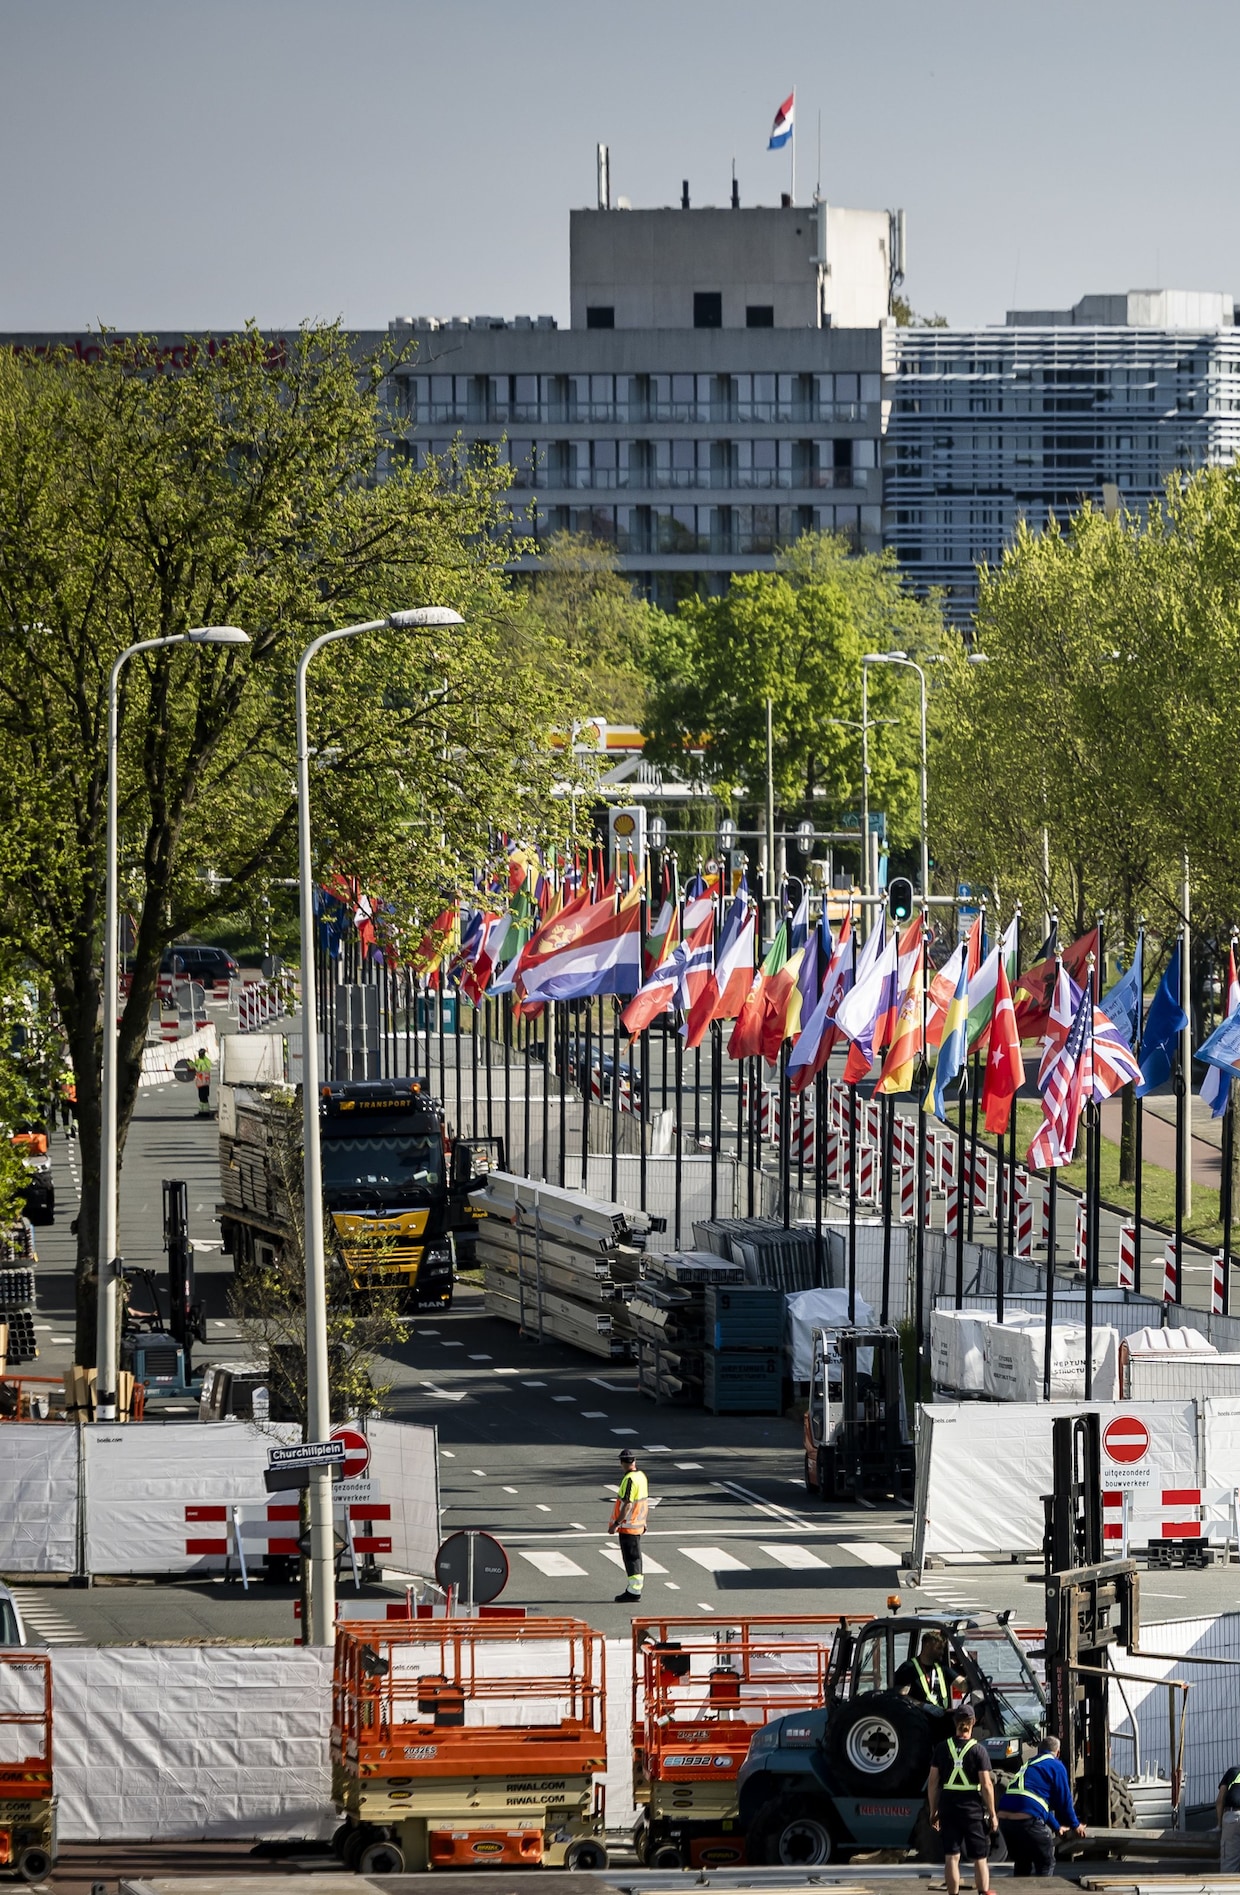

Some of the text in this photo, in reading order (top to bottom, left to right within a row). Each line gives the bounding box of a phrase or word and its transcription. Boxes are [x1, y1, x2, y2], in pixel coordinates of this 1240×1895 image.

[360, 1100, 411, 1109] TRANSPORT
[361, 1223, 401, 1231] MAN
[418, 1300, 445, 1308] MAN
[720, 1294, 731, 1310] 9
[1053, 1359, 1097, 1368] NEPTUNS
[273, 1443, 340, 1460] Churchillplein
[1104, 1469, 1151, 1479] uitgezonderd
[1105, 1480, 1150, 1488] bouwverkeer
[333, 1494, 371, 1502] uwverkeer
[663, 1756, 712, 1767] ES1932
[506, 1782, 566, 1792] RIWAL.COM
[506, 1795, 565, 1806] RIWAL.COM
[859, 1804, 913, 1817] NEPTUNUS
